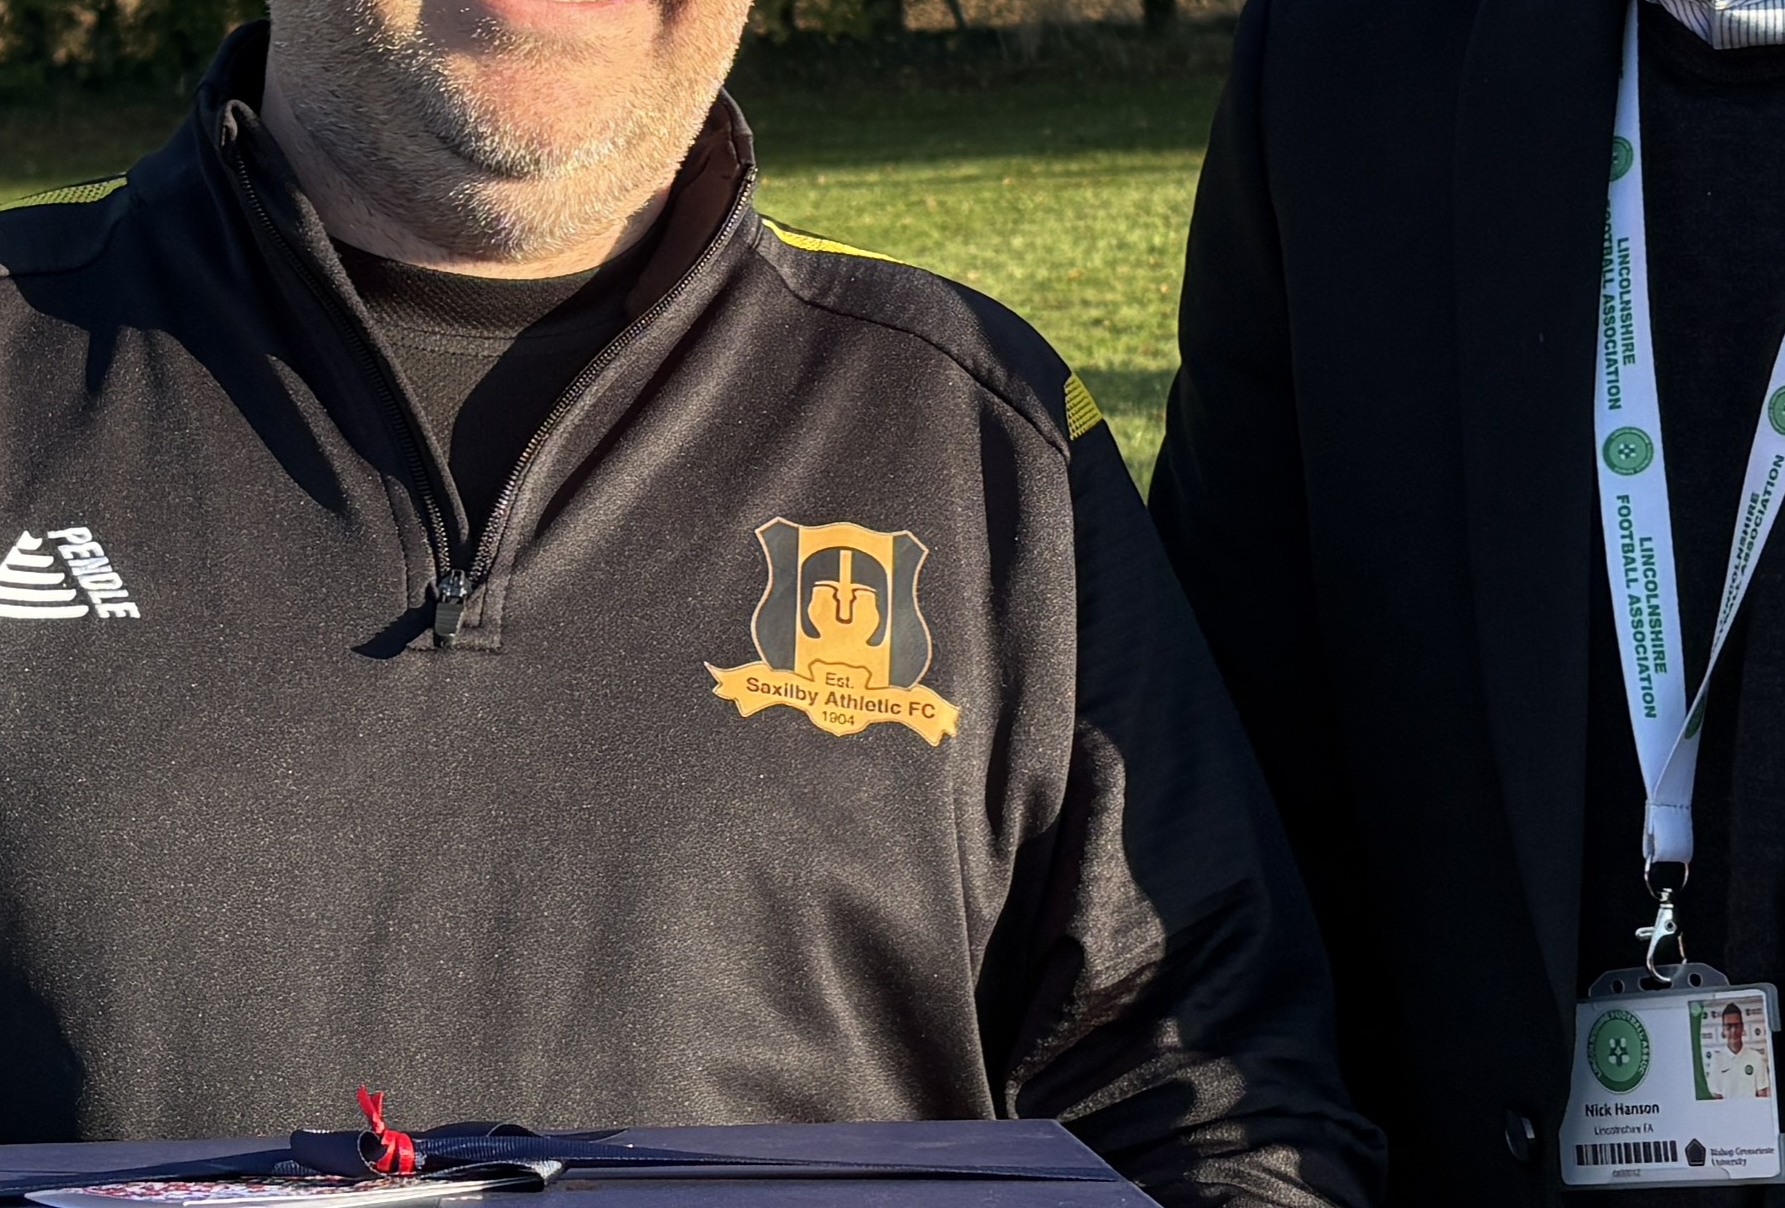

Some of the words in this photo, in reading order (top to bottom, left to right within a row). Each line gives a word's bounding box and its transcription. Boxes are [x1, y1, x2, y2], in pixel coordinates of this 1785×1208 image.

[1602, 294, 1622, 410] ASSOCIATION
[1617, 237, 1635, 366] LINCOLNSHIRE
[1741, 455, 1785, 576] ASSOCIATION
[47, 527, 141, 619] PENDLE
[1616, 495, 1639, 589] FOOTBALL
[1628, 594, 1657, 718] ASSOCIATION
[1639, 537, 1667, 673] LINCOLNSHIRE
[746, 676, 818, 707] Saxilby
[824, 690, 901, 716] Athletic
[908, 701, 936, 719] FC
[822, 710, 855, 727] 1904
[825, 672, 854, 689] Est.
[1585, 1103, 1612, 1117] Nick
[1615, 1102, 1660, 1116] Hanson
